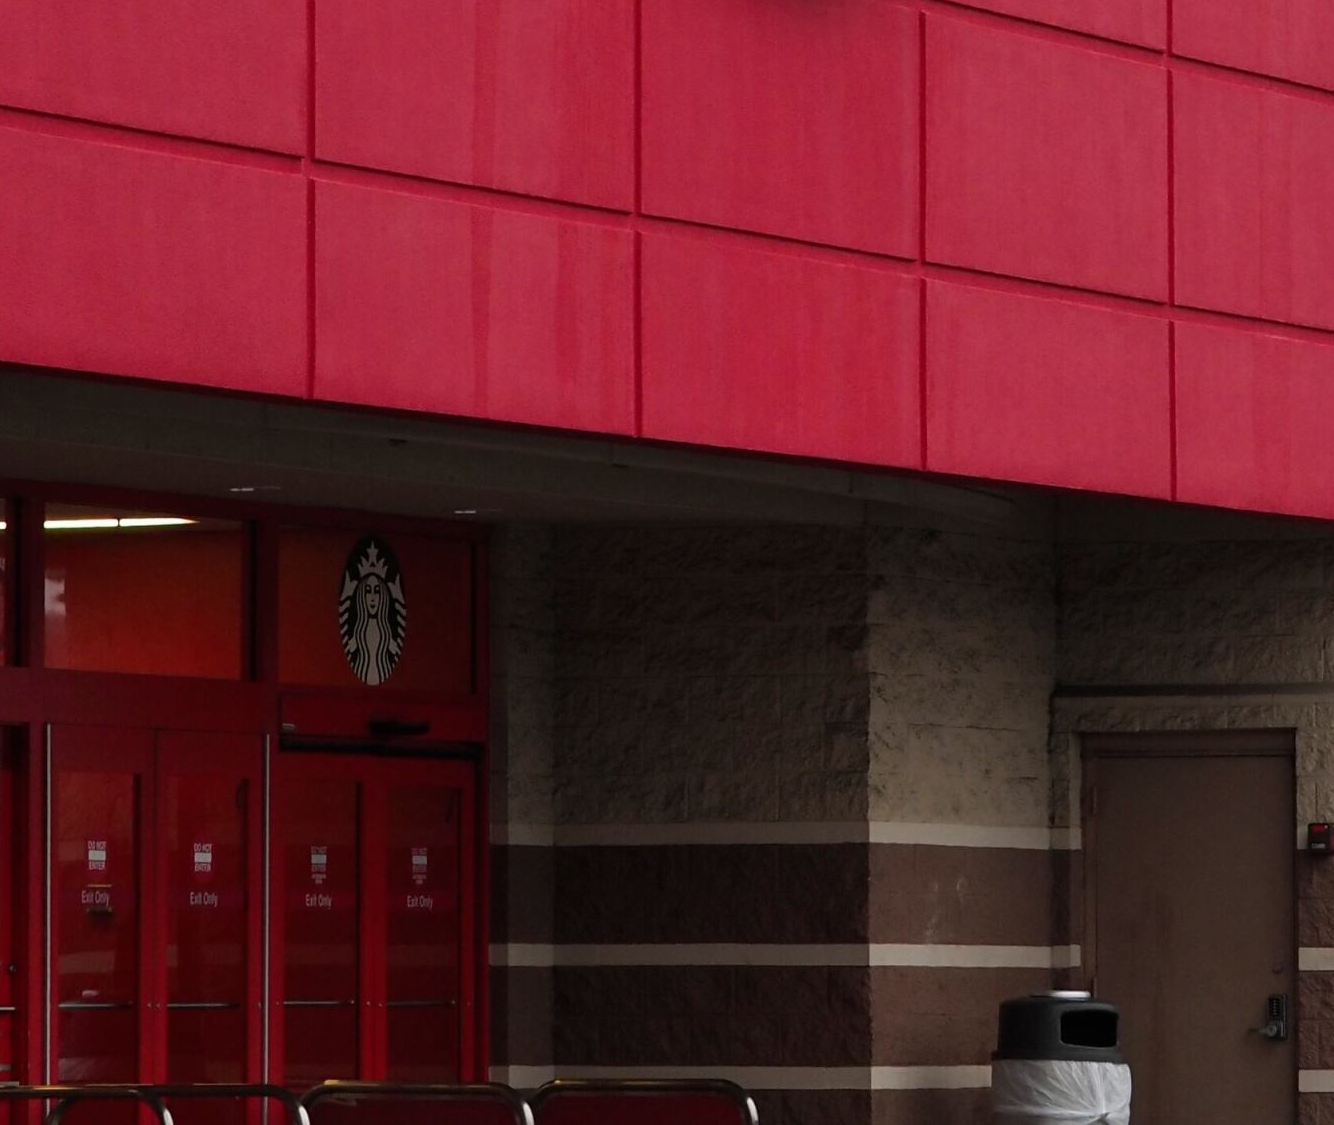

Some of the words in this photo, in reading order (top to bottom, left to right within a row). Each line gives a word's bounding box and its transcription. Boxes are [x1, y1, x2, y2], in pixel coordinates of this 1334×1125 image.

[81, 890, 94, 904] Exit
[95, 891, 110, 907] Only
[190, 891, 202, 905] Exit
[203, 892, 218, 907] Only
[305, 893, 317, 907] Exit
[318, 894, 332, 910] Only
[407, 895, 418, 908] Exit
[419, 896, 433, 911] Only
